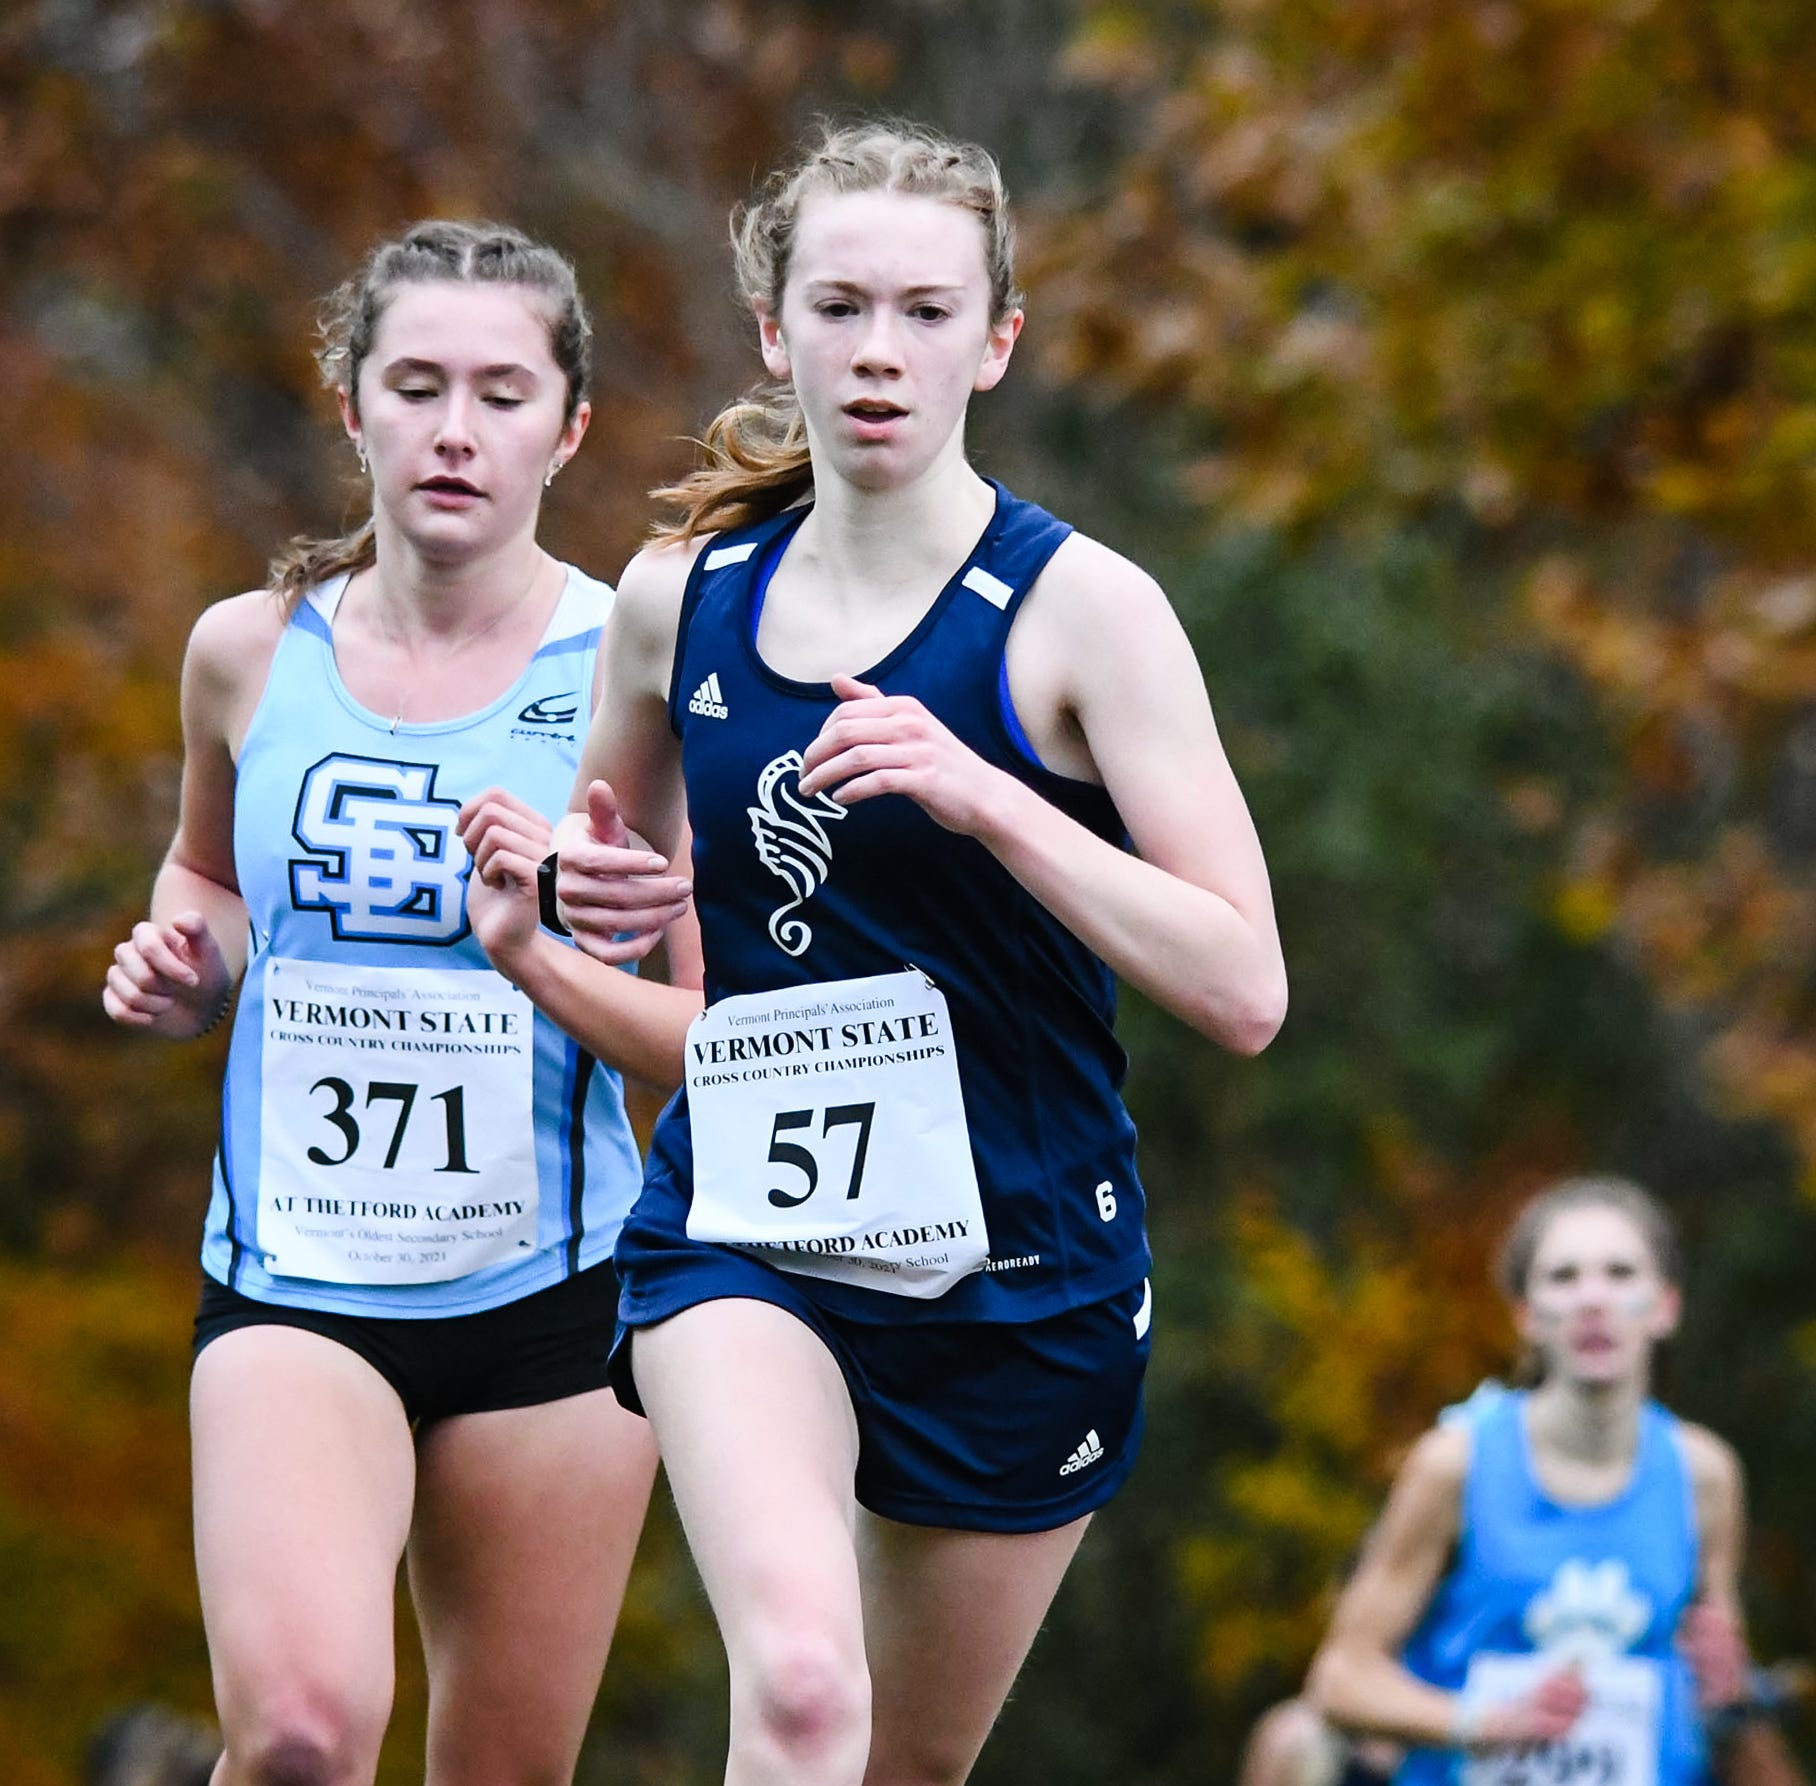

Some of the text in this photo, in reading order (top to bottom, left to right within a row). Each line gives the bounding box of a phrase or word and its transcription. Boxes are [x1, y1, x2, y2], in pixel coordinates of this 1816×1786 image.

[689, 699, 728, 719] adidas
[305, 977, 349, 995] Vermont
[273, 998, 519, 1036] VERMONT STATE
[728, 1012, 771, 1026] Vermont
[830, 997, 896, 1015] Association
[270, 1030, 521, 1055] CROSS COUNTRY CHAMPIONSHIPS
[693, 1012, 939, 1065] VERMONT STATE
[693, 1045, 945, 1088] CROSS COUNTRY CHAMPIONSHIPS
[307, 1077, 480, 1174] 371
[767, 1102, 876, 1208] 57
[271, 1196, 525, 1221] AT THETFORD ACADEMY
[1095, 1180, 1117, 1223] 6
[462, 1226, 503, 1241] School
[861, 1220, 969, 1250] ACADEMY
[905, 1252, 949, 1268] School
[1059, 1447, 1104, 1476] adidas
